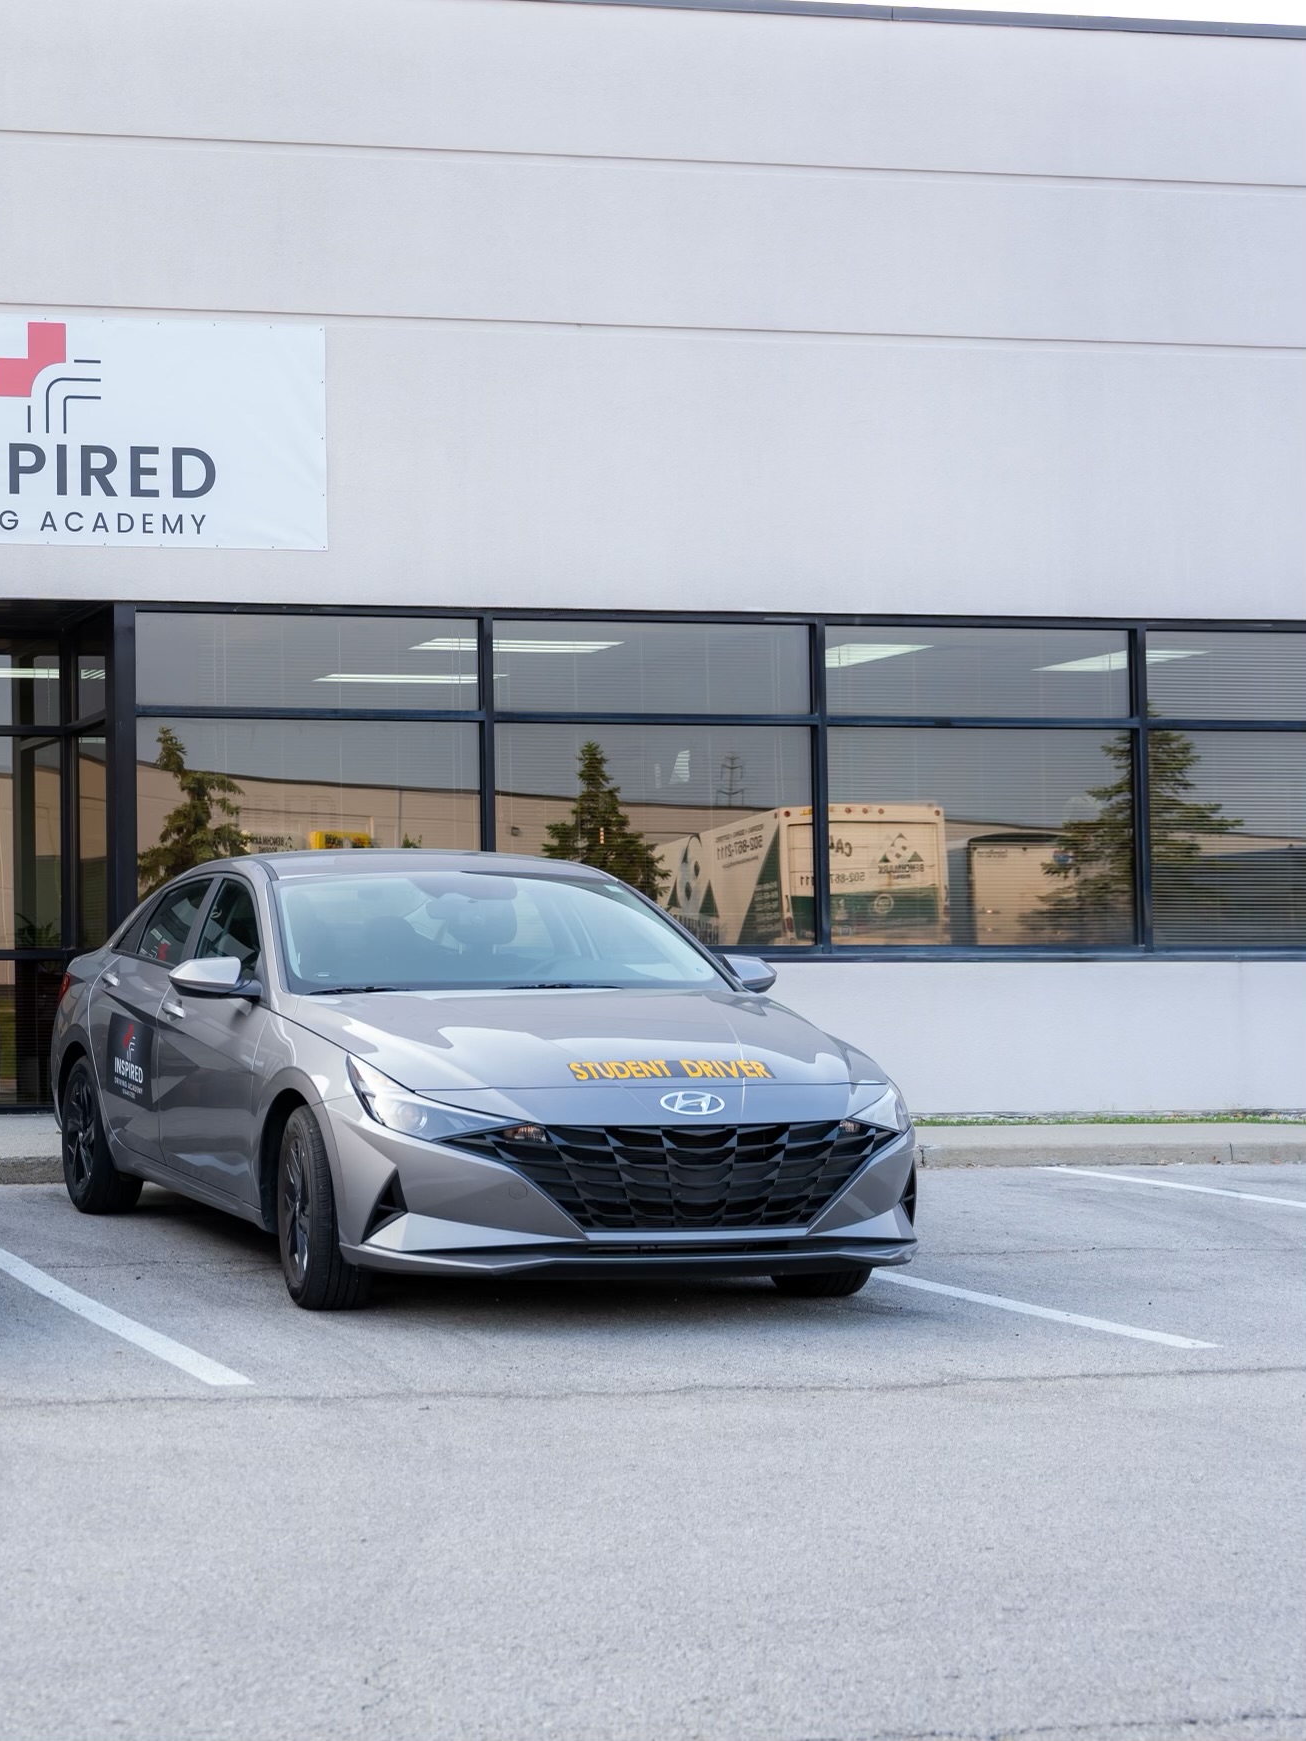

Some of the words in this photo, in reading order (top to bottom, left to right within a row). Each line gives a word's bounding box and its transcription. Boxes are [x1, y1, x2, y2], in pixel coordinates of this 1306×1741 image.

[39, 509, 208, 535] ACADEMY
[114, 1056, 144, 1084] INSPIRED
[569, 1059, 672, 1081] STUDENT
[679, 1058, 773, 1079] DRIVER
